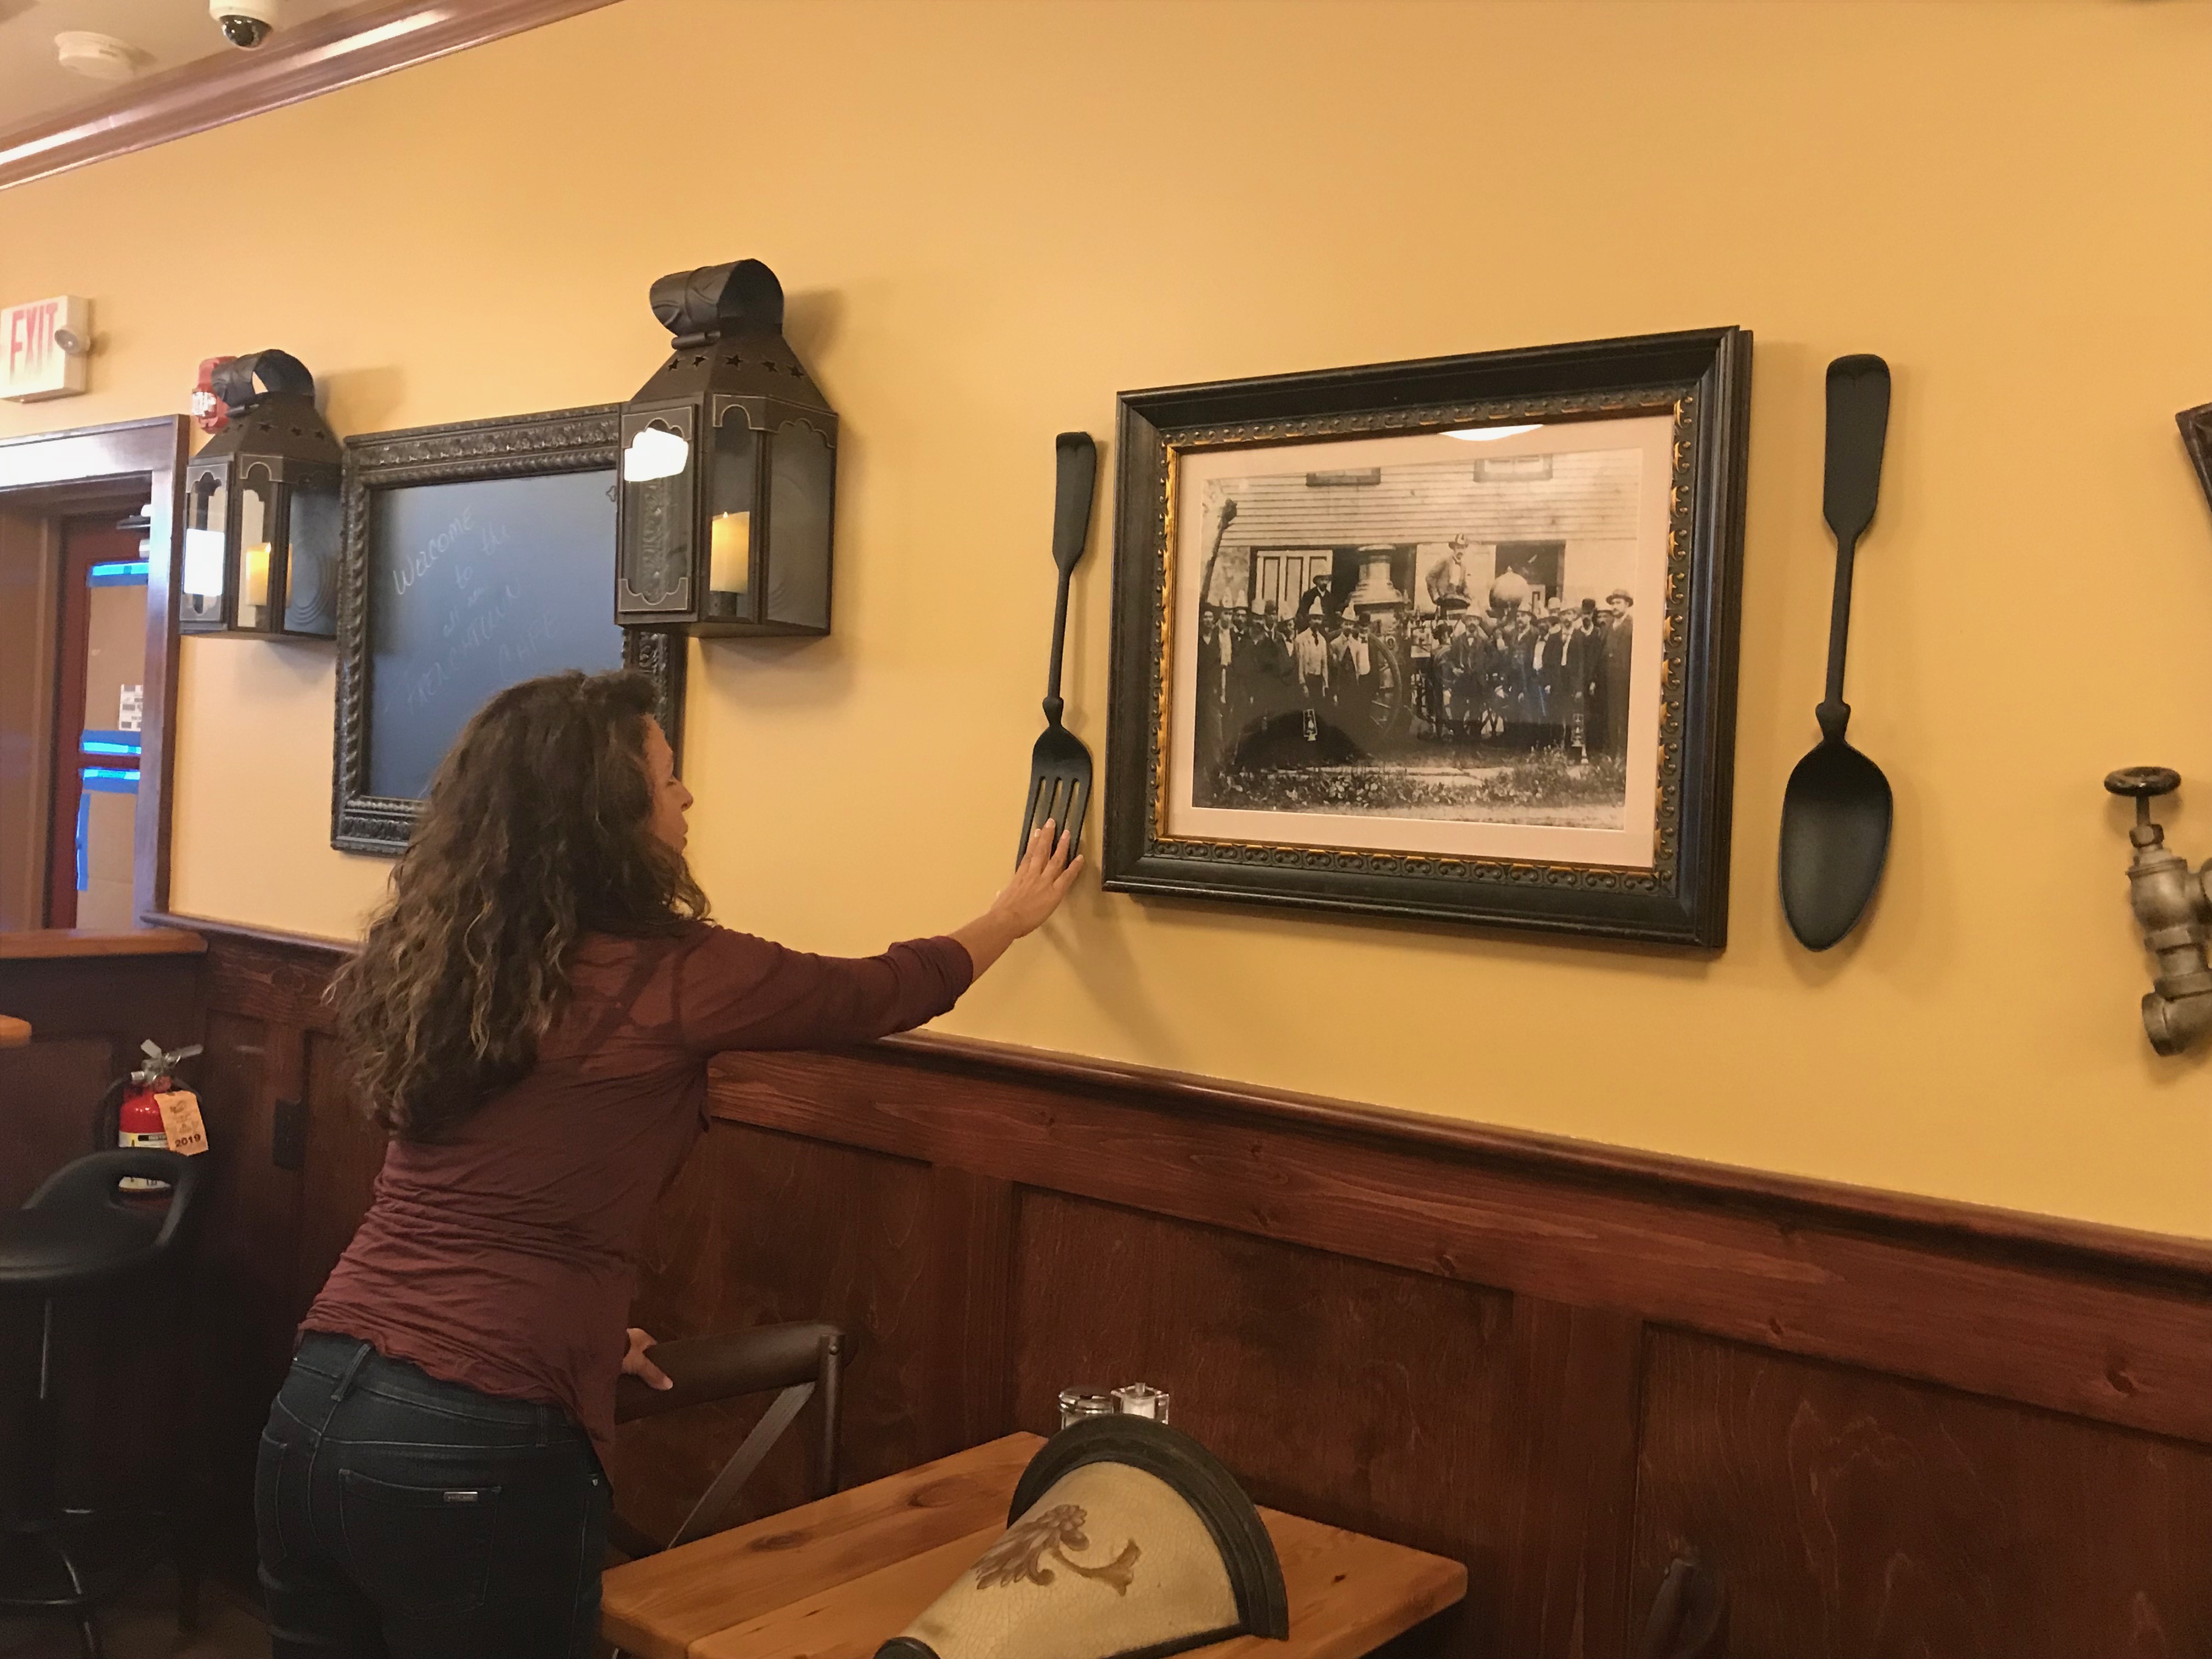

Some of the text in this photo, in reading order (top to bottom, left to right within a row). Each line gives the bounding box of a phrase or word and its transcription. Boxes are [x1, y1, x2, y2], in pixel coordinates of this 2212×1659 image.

[10, 302, 59, 380] EXIT
[455, 521, 511, 590] to the
[174, 1133, 201, 1147] 2019
